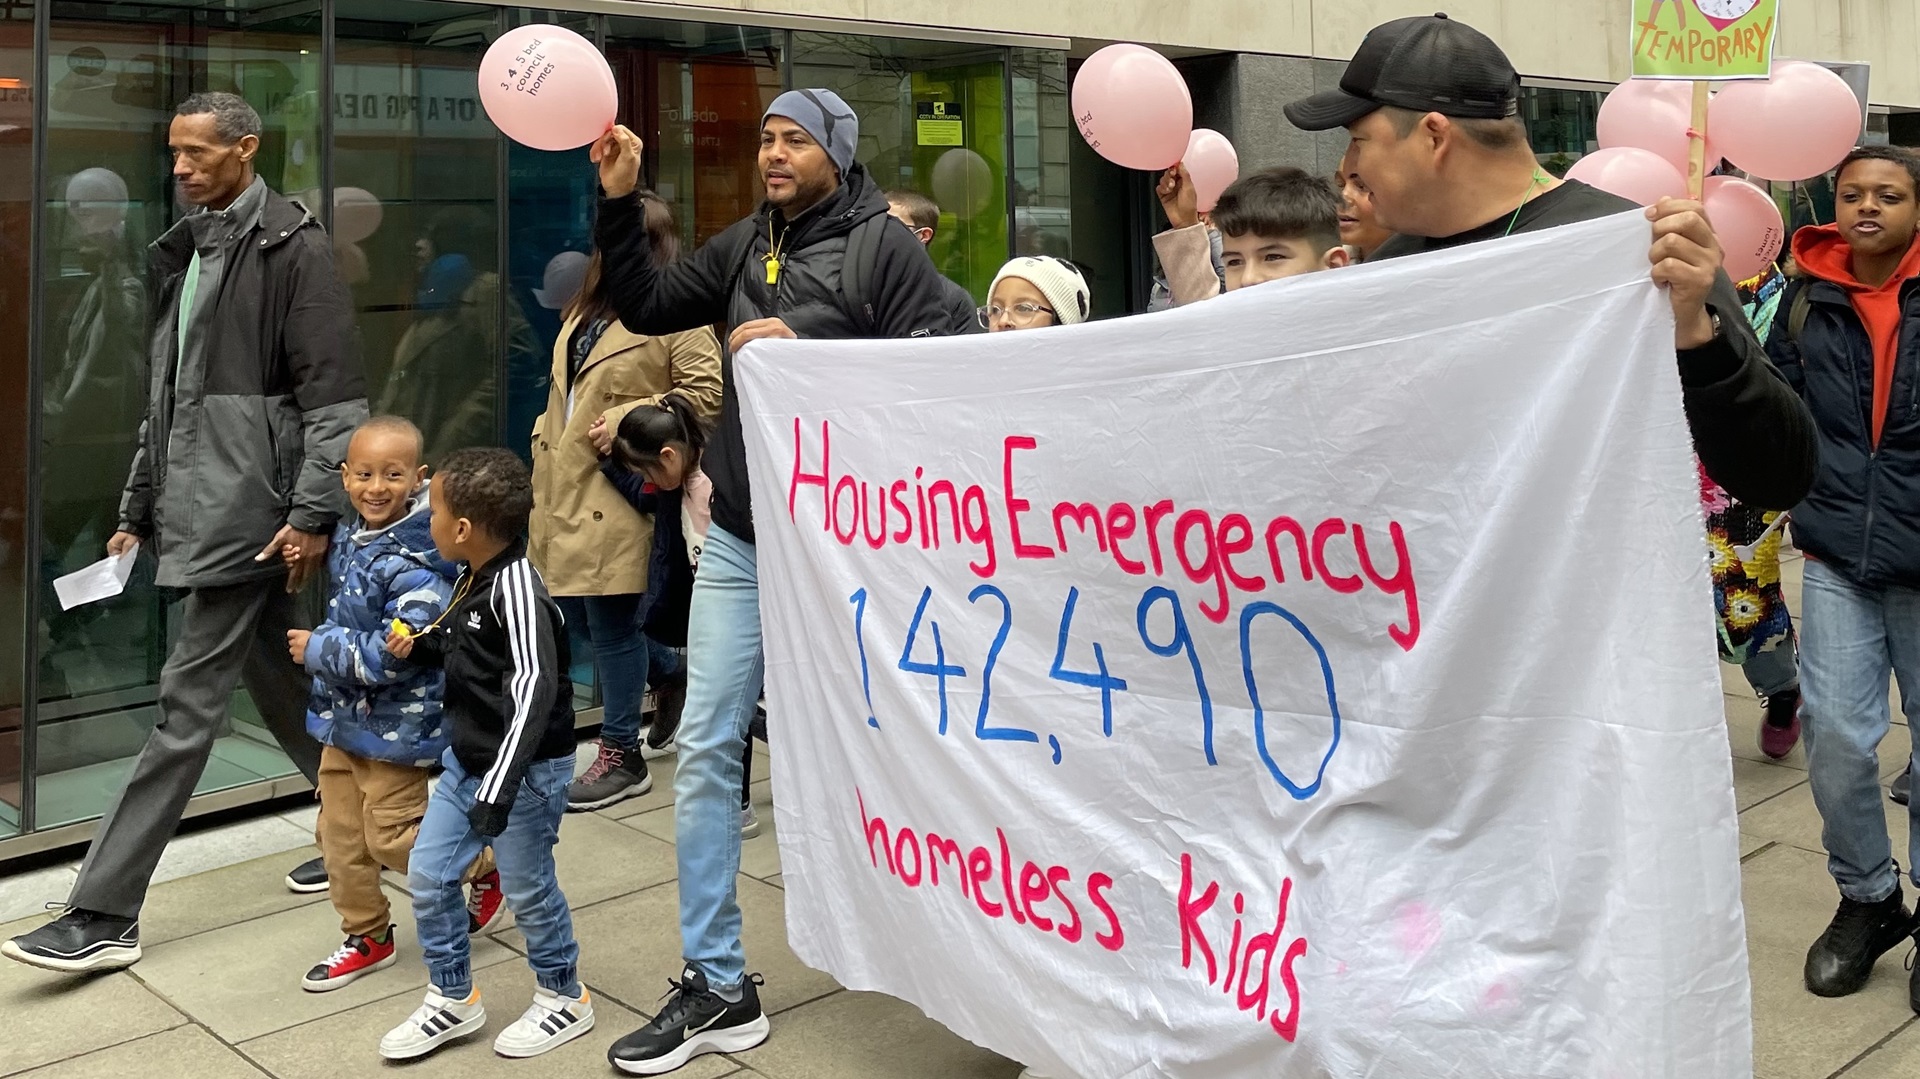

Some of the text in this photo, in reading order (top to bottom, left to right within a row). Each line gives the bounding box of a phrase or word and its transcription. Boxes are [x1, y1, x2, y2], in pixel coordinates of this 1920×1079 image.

[523, 38, 542, 55] bed
[1635, 16, 1772, 67] TEMPORARY
[516, 53, 546, 92] council
[526, 62, 555, 97] homes
[1755, 226, 1773, 257] homes
[788, 417, 1420, 651] Housing Emergency
[849, 584, 1341, 800] 142,490
[856, 786, 1125, 951] homeless
